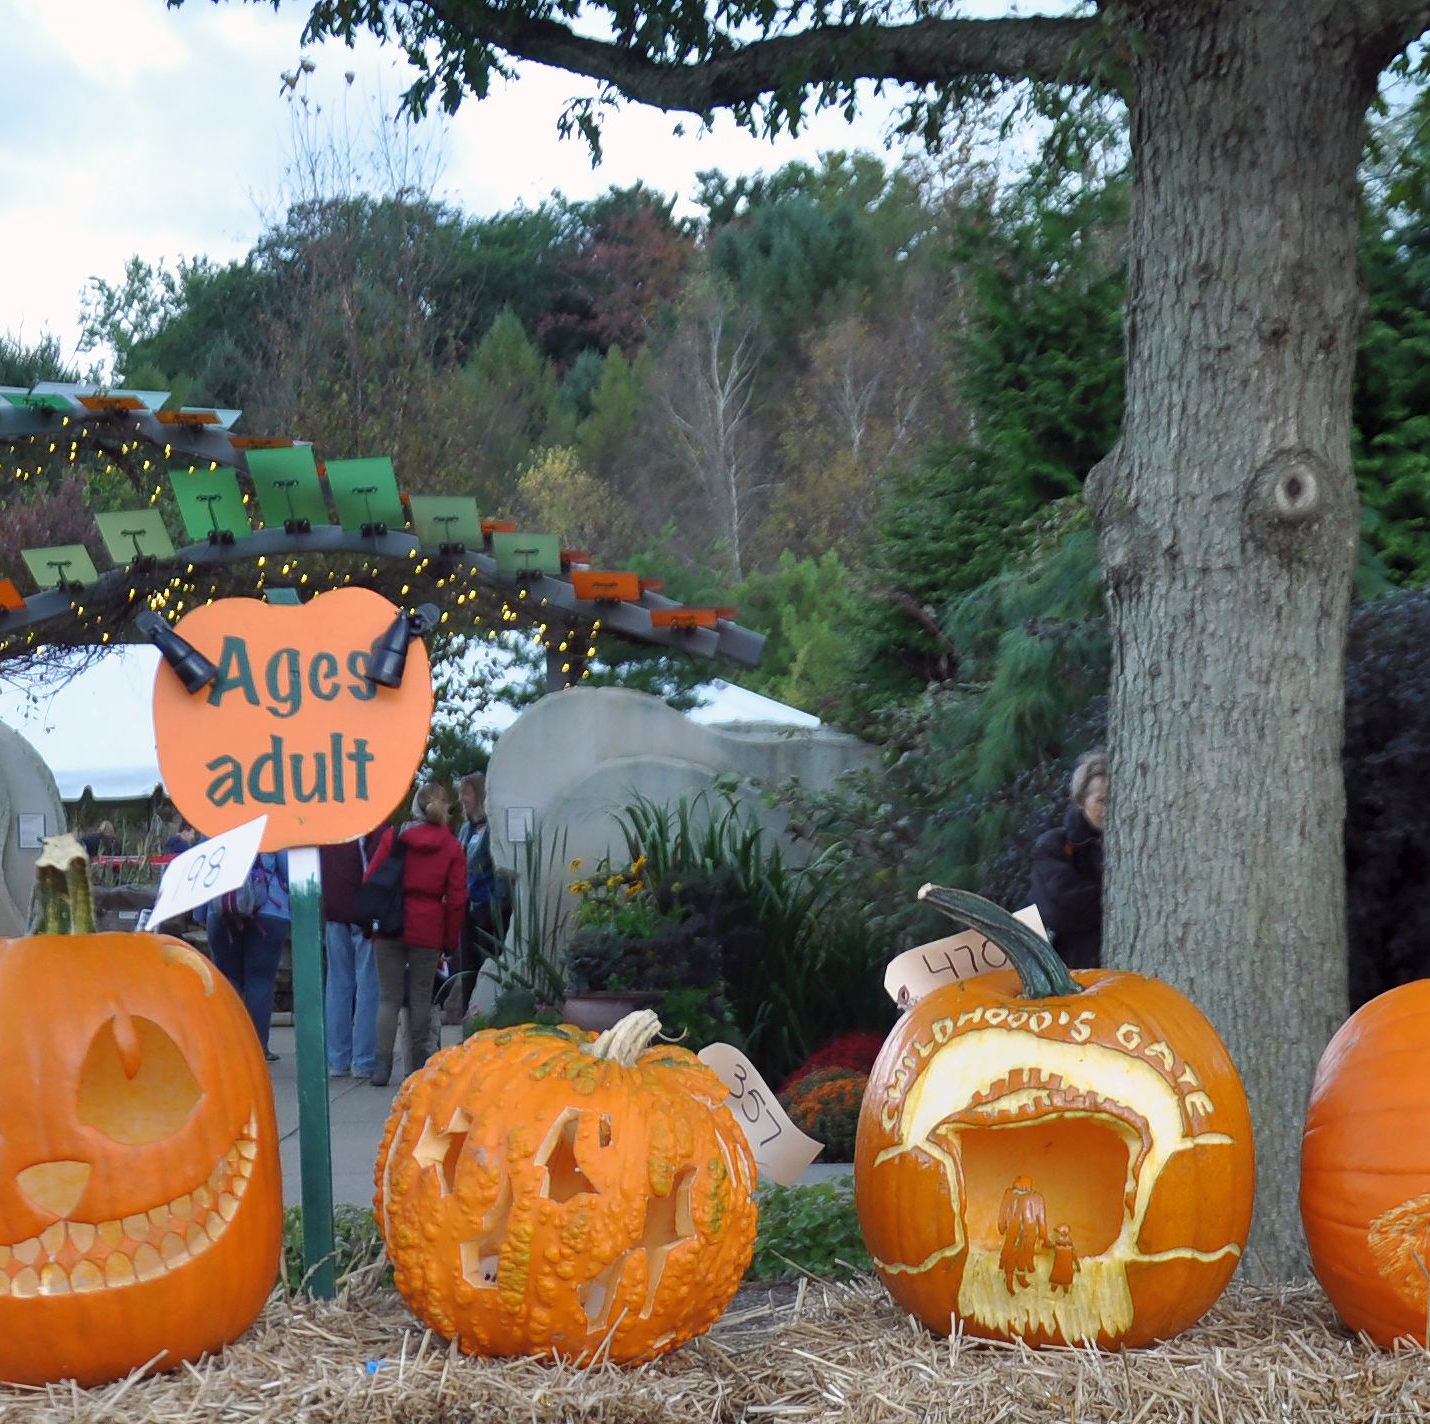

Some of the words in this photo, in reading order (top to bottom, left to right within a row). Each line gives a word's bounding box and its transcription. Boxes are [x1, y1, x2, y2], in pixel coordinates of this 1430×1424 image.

[206, 636, 378, 719] Ages
[205, 732, 375, 806] adult
[171, 845, 226, 902] 198
[921, 937, 1007, 981] 470
[729, 1063, 782, 1148] 357
[880, 1006, 1097, 1133] CHILDHOOD'S
[1115, 1022, 1216, 1118] GATE
